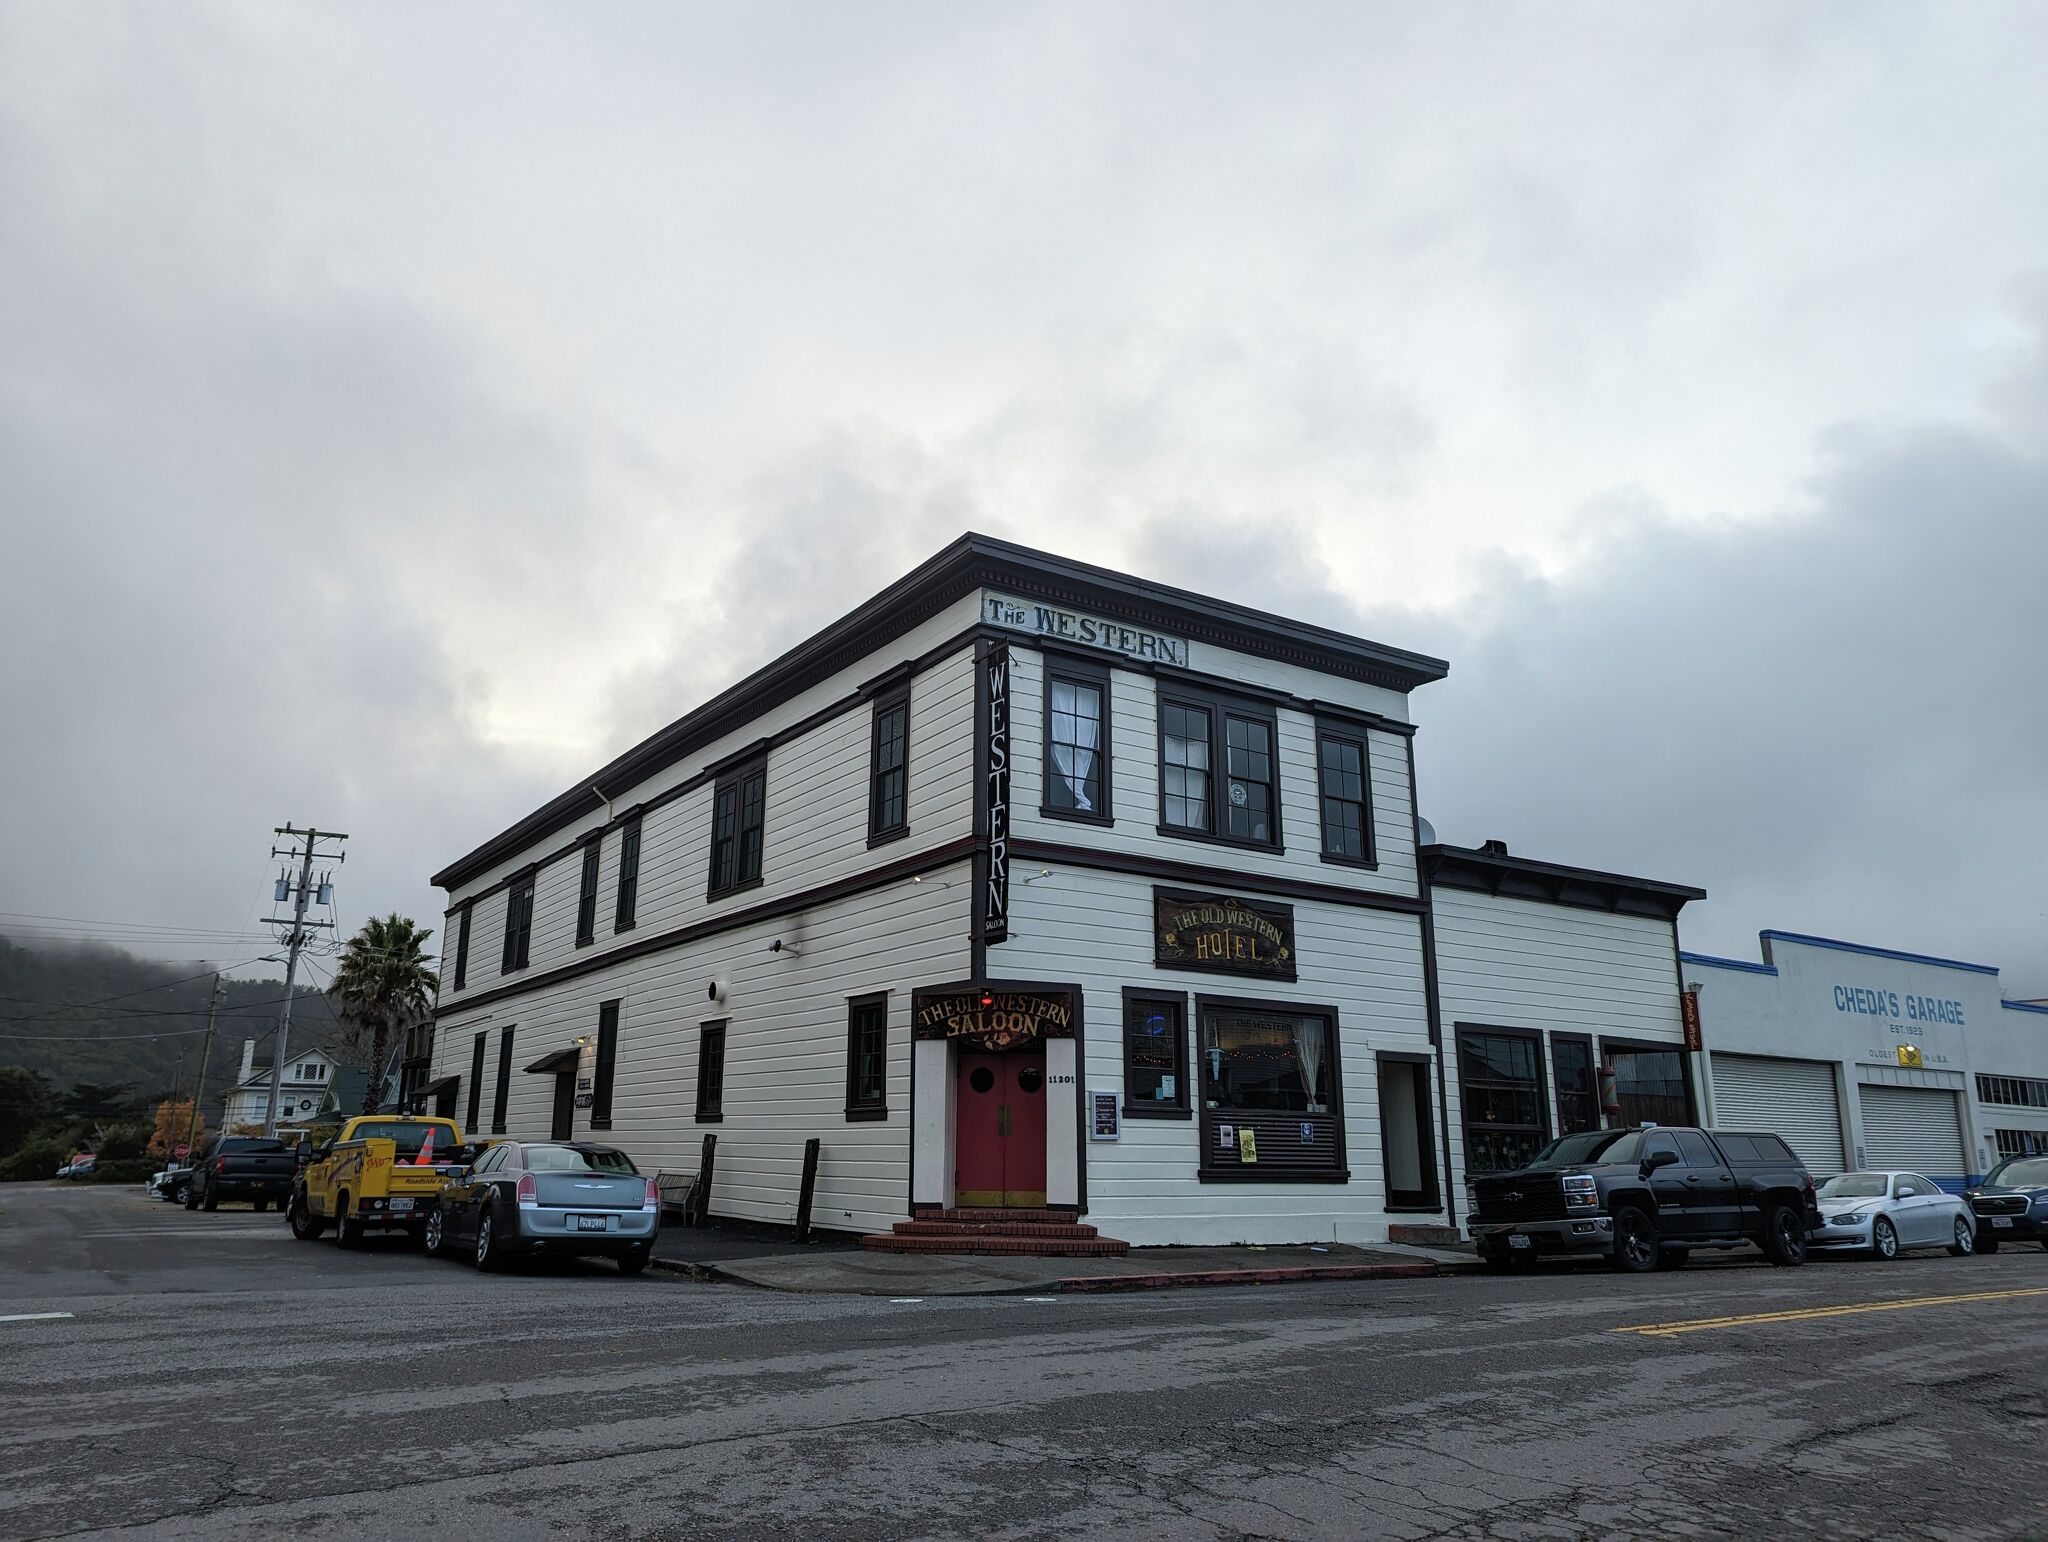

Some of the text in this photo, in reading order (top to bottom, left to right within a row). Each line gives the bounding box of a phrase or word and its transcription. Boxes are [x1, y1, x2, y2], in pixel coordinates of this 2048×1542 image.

[987, 661, 1007, 918] WESTERN
[985, 918, 1005, 931] SALOON
[1173, 908, 1284, 946] THE OLD WESTERN
[1196, 928, 1264, 960] HOTEL
[919, 1001, 956, 1026] THE
[991, 994, 1072, 1028] WESTERN
[1833, 985, 1965, 1026] CHEDA'S GARAGE
[946, 1012, 1042, 1037] SALOON
[1253, 1019, 1293, 1032] WESTERN
[1048, 1075, 1075, 1084] 11201
[405, 1177, 436, 1185] Roadside
